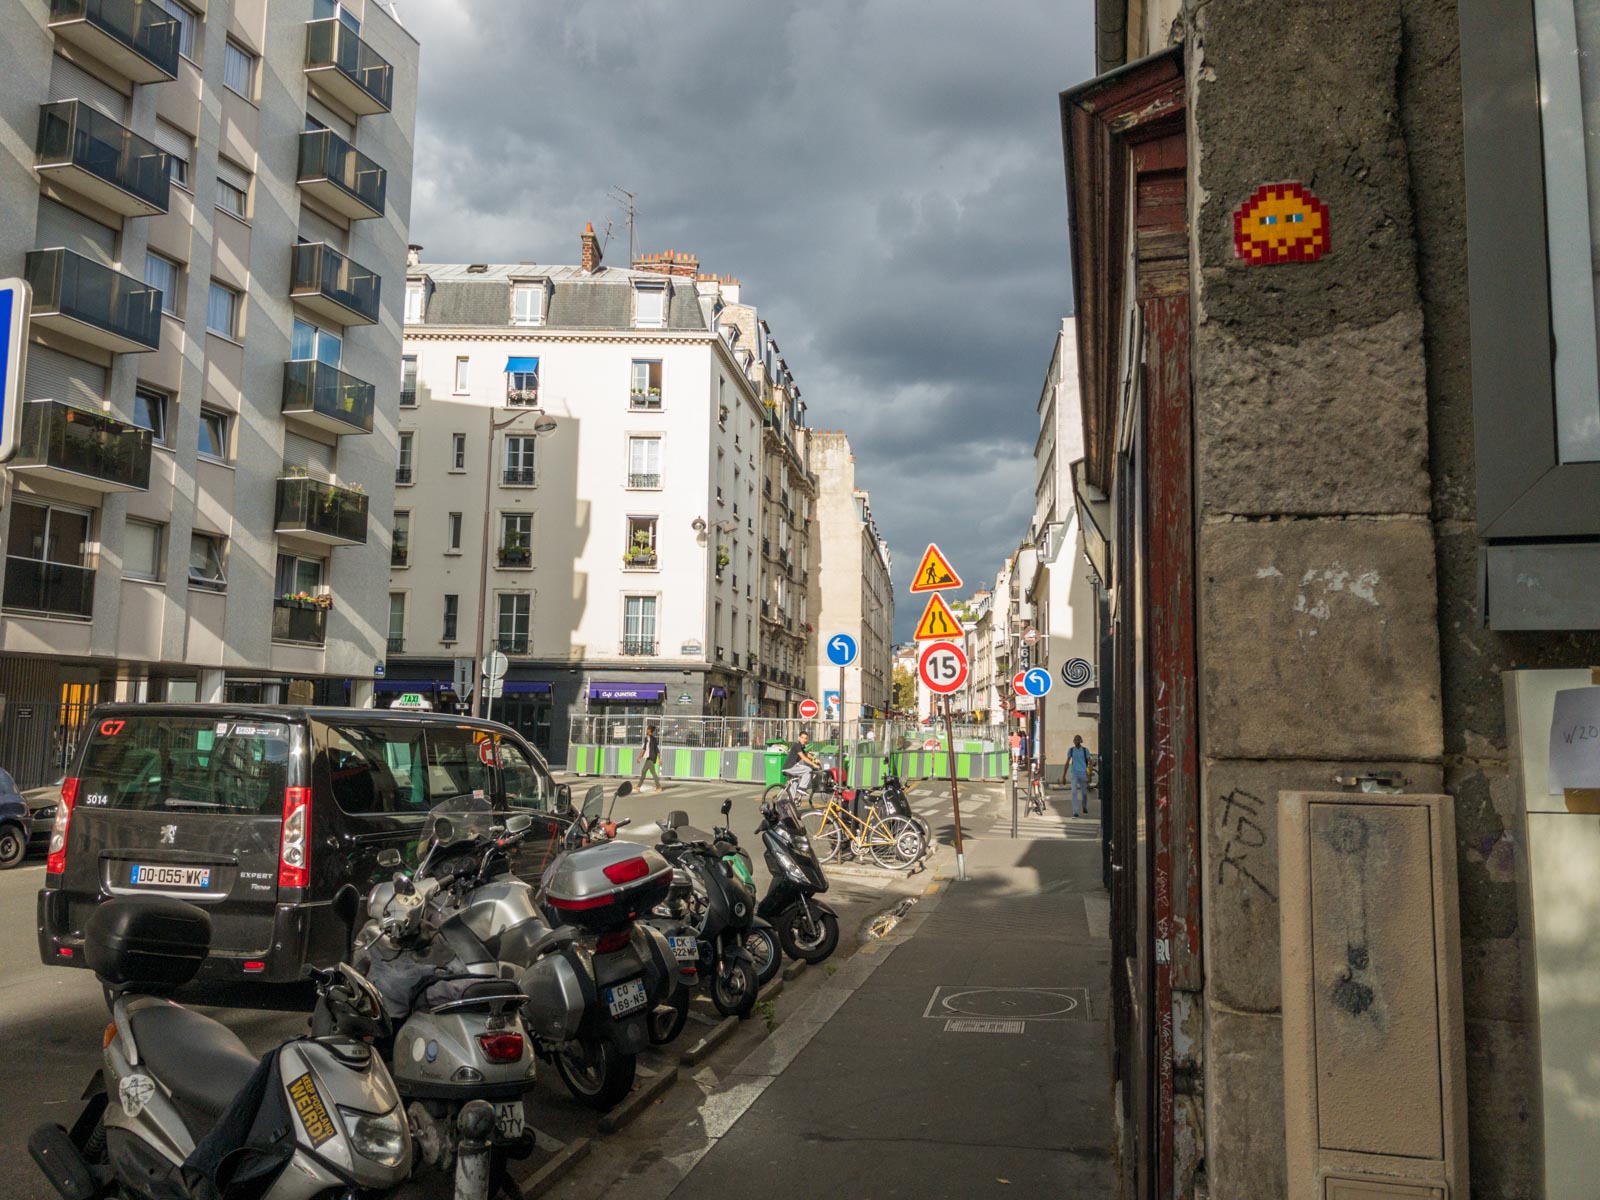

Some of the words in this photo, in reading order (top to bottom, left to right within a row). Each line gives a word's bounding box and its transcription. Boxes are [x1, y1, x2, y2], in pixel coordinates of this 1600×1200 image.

[929, 656, 957, 679] 15
[403, 695, 419, 703] TAXI
[100, 720, 126, 736] G7
[86, 794, 108, 805] 5014
[240, 871, 273, 880] EXPERT
[613, 992, 645, 1013] 169-NS
[290, 1080, 327, 1143] WEIRD!
[301, 1074, 316, 1095] KEEP
[311, 1094, 335, 1137] PORTLAND
